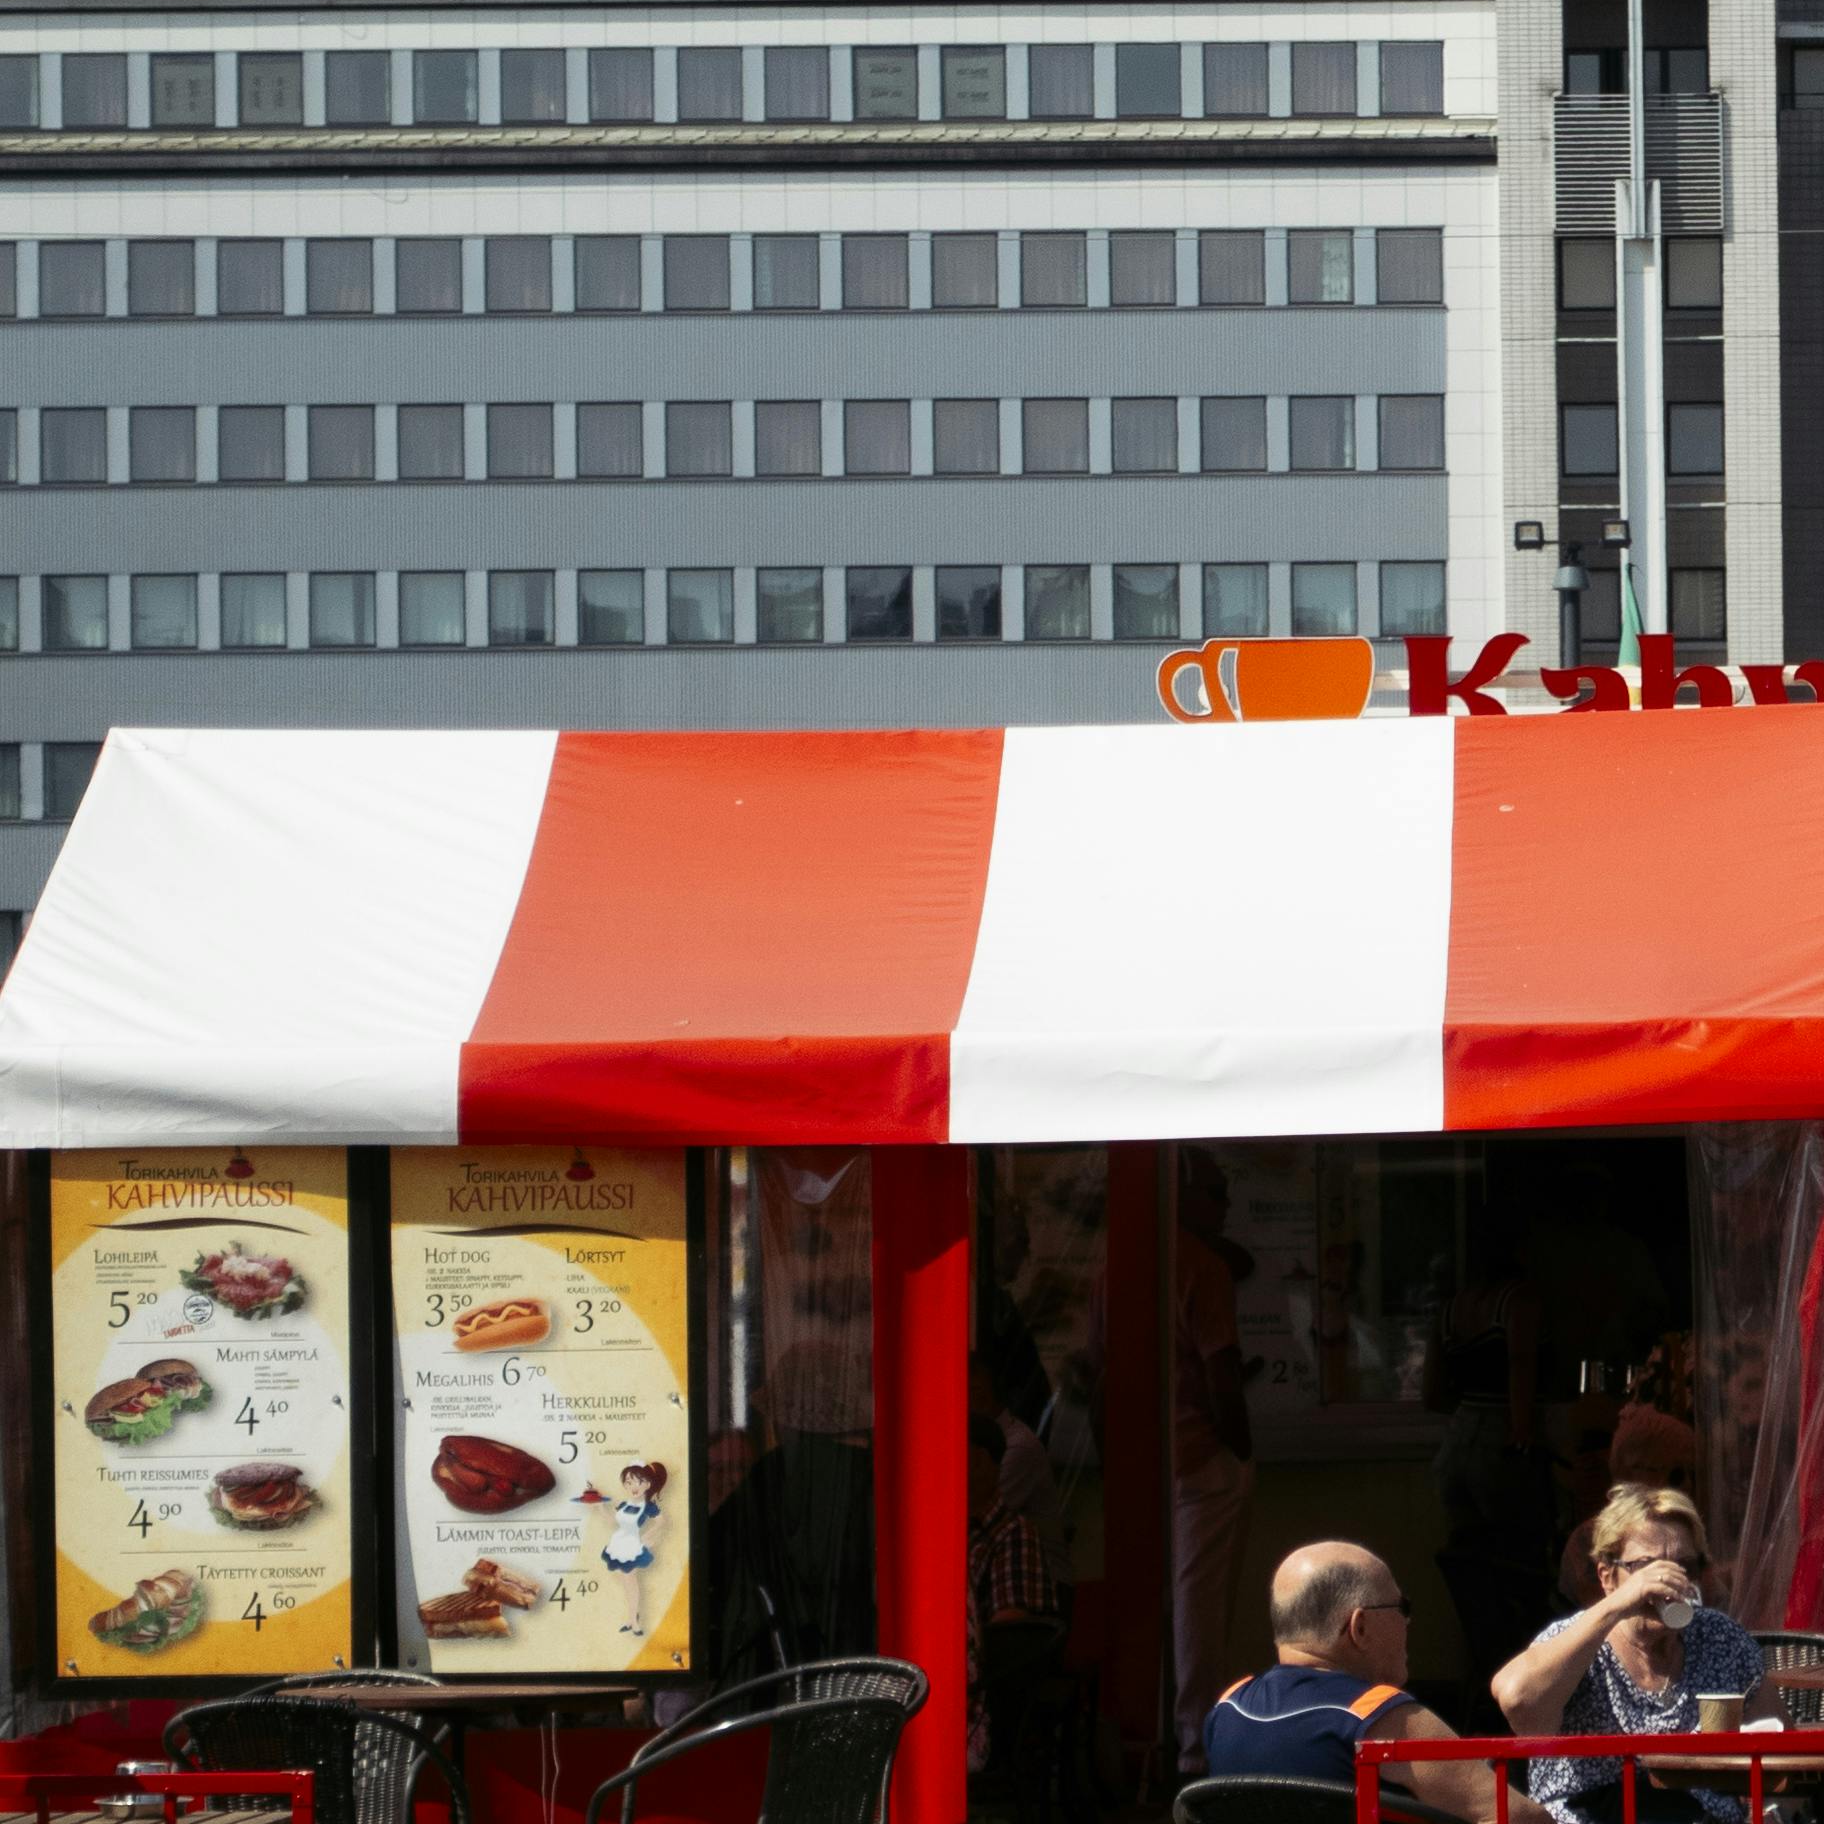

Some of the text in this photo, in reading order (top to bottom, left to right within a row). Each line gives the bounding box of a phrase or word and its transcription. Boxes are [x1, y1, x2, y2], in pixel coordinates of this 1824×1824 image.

[119, 1160, 219, 1180] TORIKAHVILA
[106, 1181, 294, 1210] KAHVIPAUSSI
[447, 1183, 634, 1213] KAHVIPAUSSI
[425, 1247, 490, 1264] HOT DOG
[108, 1290, 158, 1328] 5 20
[425, 1294, 473, 1328] 3 50
[573, 1299, 621, 1334] 3 20
[216, 1348, 260, 1363] MAHTI
[416, 1371, 494, 1387] MEGALIHIS
[502, 1356, 521, 1386] 6
[235, 1396, 289, 1436] 4 40
[542, 1392, 638, 1409] HERKKULIHIS
[558, 1431, 607, 1464] 5 20
[96, 1467, 209, 1482] TUHTI REISSUMIES
[126, 1498, 182, 1539] 4 90
[259, 1567, 327, 1580] CROISSANT
[549, 1578, 599, 1612] 4 40
[241, 1591, 296, 1632] 4 60
